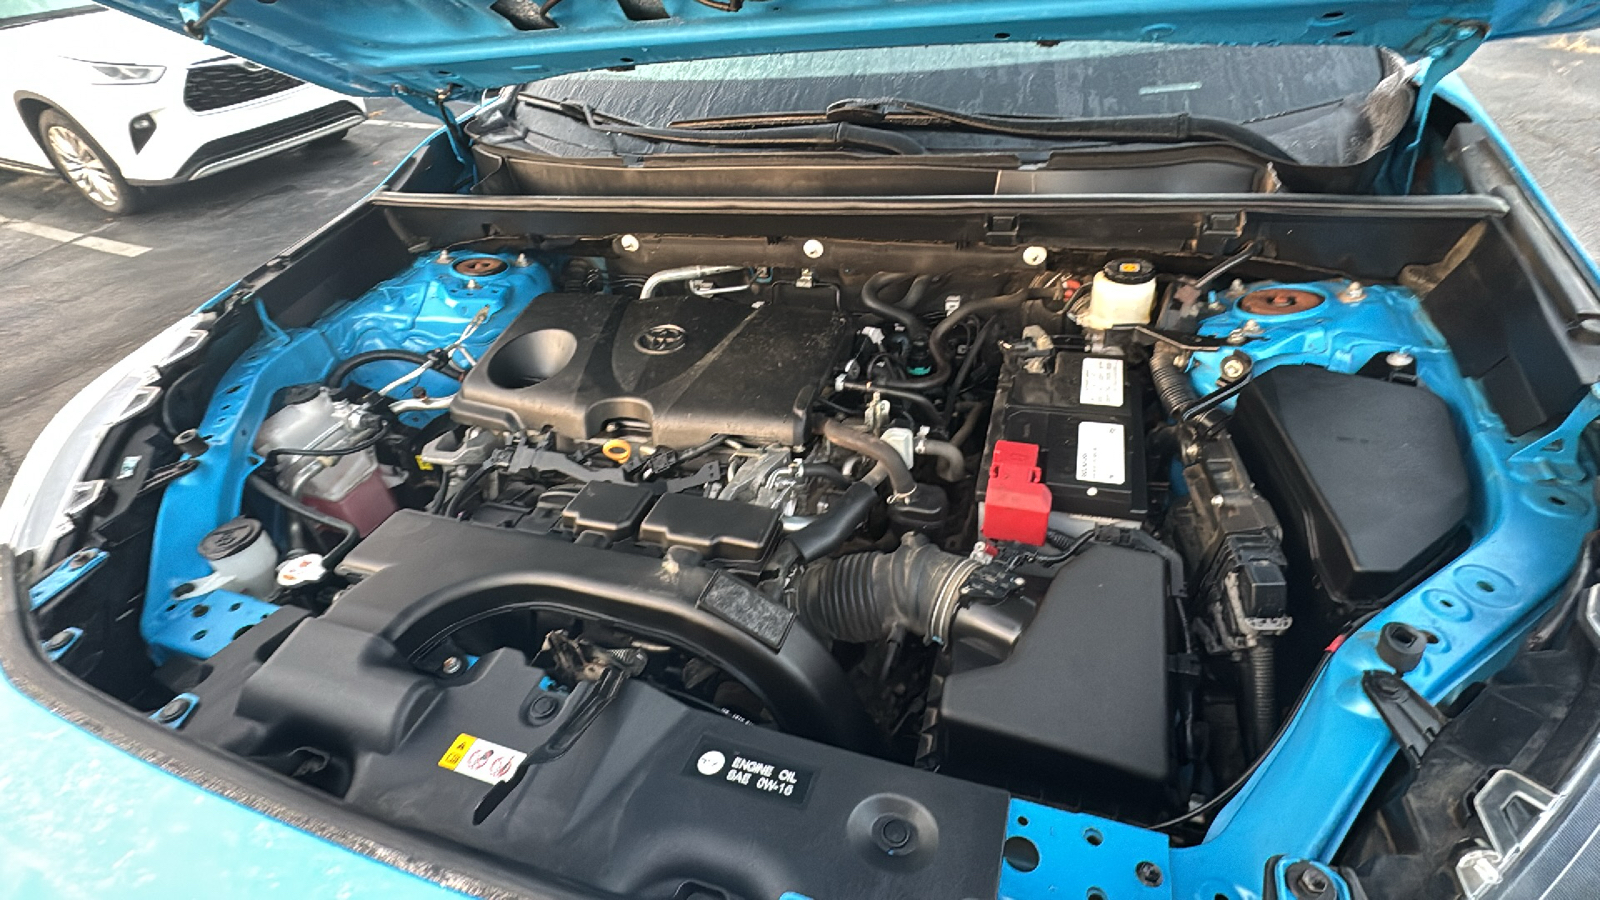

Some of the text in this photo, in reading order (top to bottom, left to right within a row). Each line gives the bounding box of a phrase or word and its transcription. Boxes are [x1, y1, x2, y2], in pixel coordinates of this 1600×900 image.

[726, 769, 752, 785] SAE
[731, 756, 798, 784] ENGINE OIL
